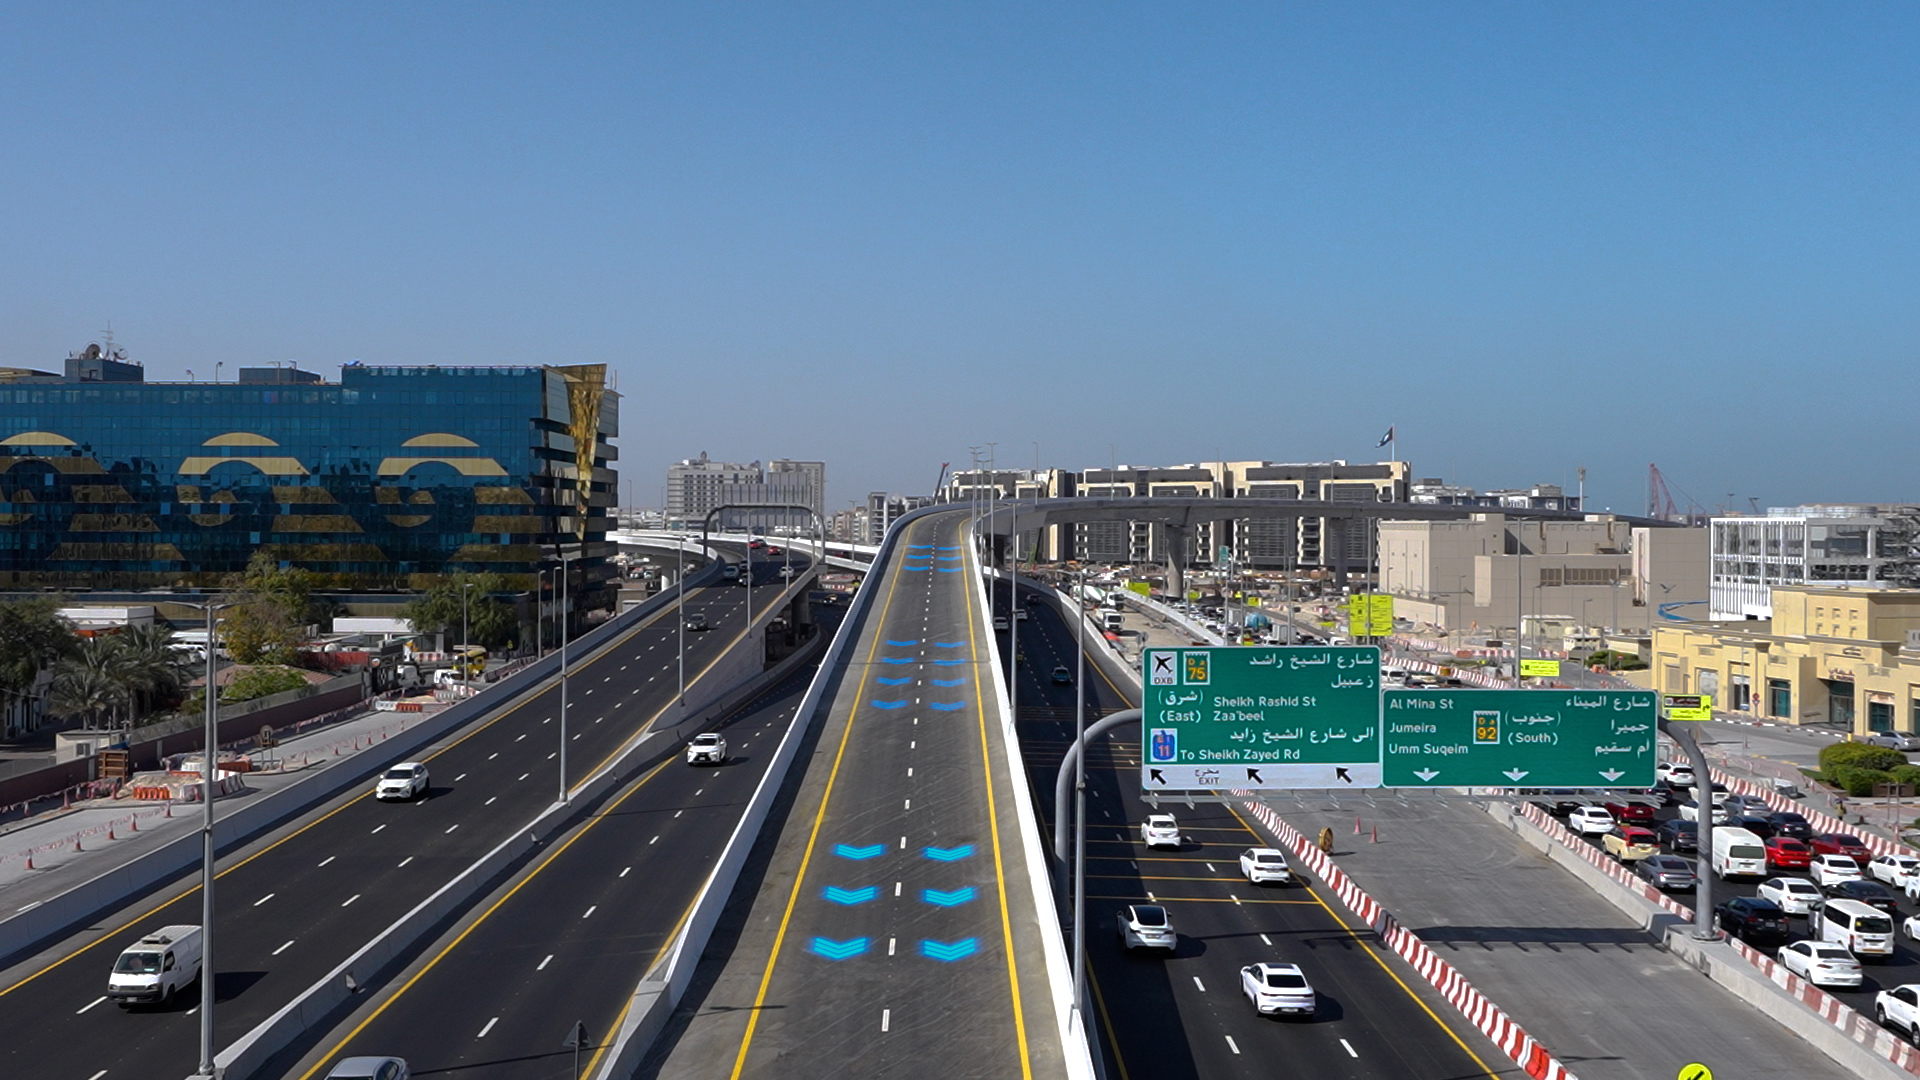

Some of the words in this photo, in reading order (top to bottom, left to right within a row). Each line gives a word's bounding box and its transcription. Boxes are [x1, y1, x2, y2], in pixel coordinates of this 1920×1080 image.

[1188, 658, 1196, 666] D
[1249, 653, 1284, 669] راشد
[1290, 653, 1330, 670] الشيخ
[1337, 653, 1374, 669] شارع
[1153, 676, 1174, 685] DXB
[1188, 667, 1206, 681] 75
[1330, 674, 1374, 688] زعبيل
[1213, 696, 1255, 708] Sheikh
[1258, 696, 1299, 707] Rashid
[1302, 696, 1317, 707] St
[1389, 698, 1403, 709] Al
[1406, 698, 1436, 709] Mina
[1439, 698, 1454, 709] St
[1565, 695, 1607, 709] الميناء
[1613, 695, 1650, 711] شارع
[1159, 709, 1202, 724] (East)
[1213, 710, 1265, 721] Zaa'beel
[1478, 717, 1486, 725] D
[1389, 722, 1437, 733] Jumeira
[1477, 727, 1496, 740] 92
[1611, 719, 1650, 735] جميرا
[1229, 727, 1256, 743] زايد
[1262, 727, 1303, 744] الشيخ
[1309, 727, 1347, 744] شارع
[1508, 732, 1559, 746] (South)
[1158, 744, 1170, 757] 11
[1180, 749, 1195, 760] To
[1199, 749, 1240, 760] Sheikh
[1243, 749, 1280, 762] Zayed
[1284, 749, 1300, 760] Rd
[1389, 743, 1420, 754] Umm
[1423, 743, 1469, 756] Suqeim
[1595, 741, 1632, 757] سقيم
[1194, 768, 1220, 777] مخرج
[1198, 776, 1220, 785] EXIT
